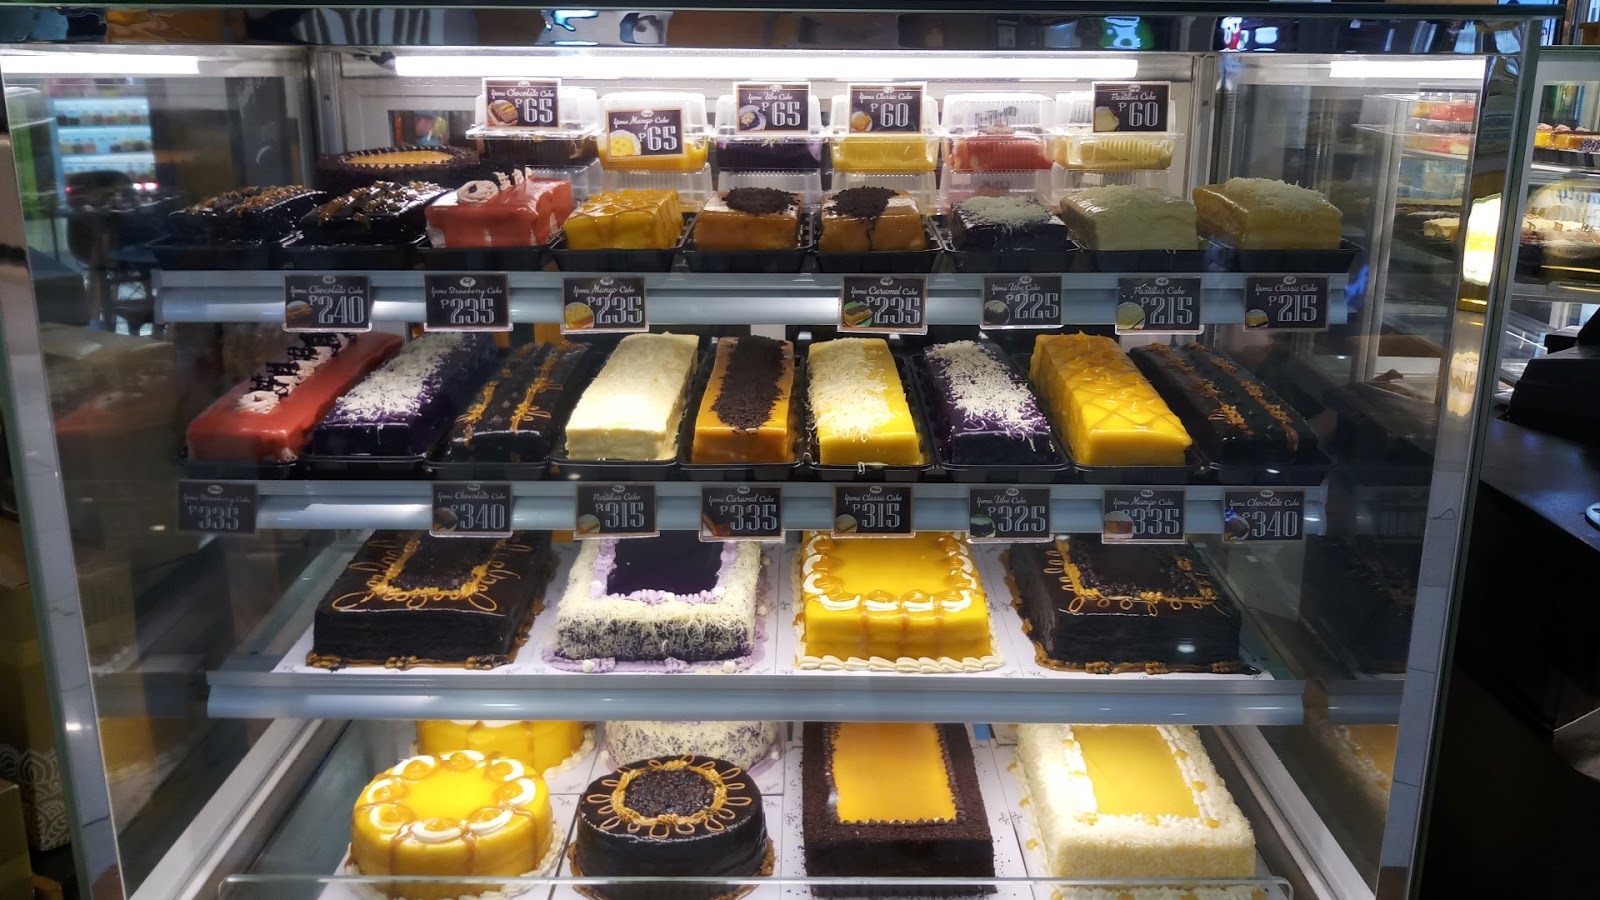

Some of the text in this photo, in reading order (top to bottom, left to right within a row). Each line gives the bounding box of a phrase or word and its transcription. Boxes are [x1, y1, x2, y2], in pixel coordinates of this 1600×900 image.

[507, 88, 538, 96] Chocolate
[629, 116, 653, 130] Mango
[309, 285, 345, 293] Chocolate
[591, 284, 617, 299] Mango
[869, 286, 902, 294] Caramel
[455, 491, 489, 499] Chocolate
[726, 494, 758, 502] Caramel
[1130, 496, 1156, 512] Mango
[1247, 497, 1282, 506] Chocolate
